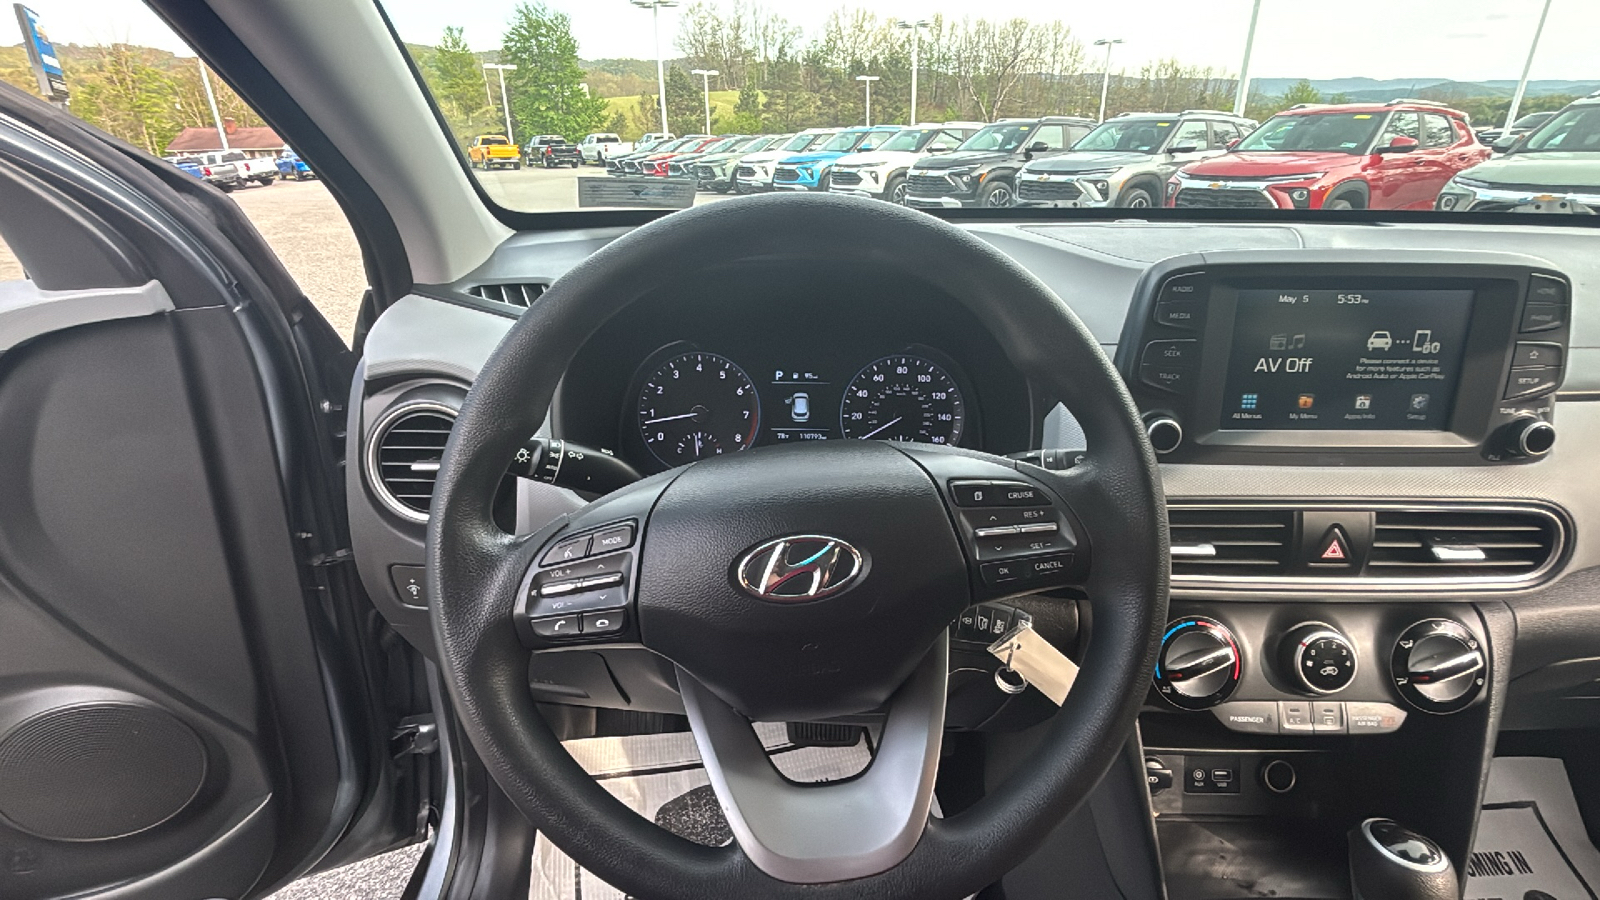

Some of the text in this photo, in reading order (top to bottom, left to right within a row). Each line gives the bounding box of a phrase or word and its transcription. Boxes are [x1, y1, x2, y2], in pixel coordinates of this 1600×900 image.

[1278, 294, 1309, 304] May 5
[696, 363, 702, 372] 4
[1254, 357, 1313, 373] AV Off
[673, 370, 679, 379] 3
[896, 366, 908, 375] 80
[719, 371, 726, 379] 5
[775, 370, 784, 381] P
[873, 374, 884, 382] 60
[917, 374, 931, 383] 100
[657, 386, 663, 394] 2
[736, 387, 743, 395] 6
[856, 389, 868, 398] 40
[932, 392, 946, 400] 120
[650, 408, 655, 417] 1
[742, 411, 749, 419] 7
[851, 412, 863, 420] 20
[937, 413, 951, 421] 140
[657, 432, 664, 441] 0
[735, 434, 742, 442] 8
[931, 435, 945, 443] 160
[1007, 491, 1034, 499] CRUISE
[1023, 511, 1038, 519] RES
[602, 536, 622, 546] MODE
[1034, 561, 1063, 571] CANCEL
[550, 570, 564, 578] VOL
[552, 601, 567, 609] VOL
[1229, 715, 1264, 724] PASSENGER
[1506, 850, 1534, 874] IN
